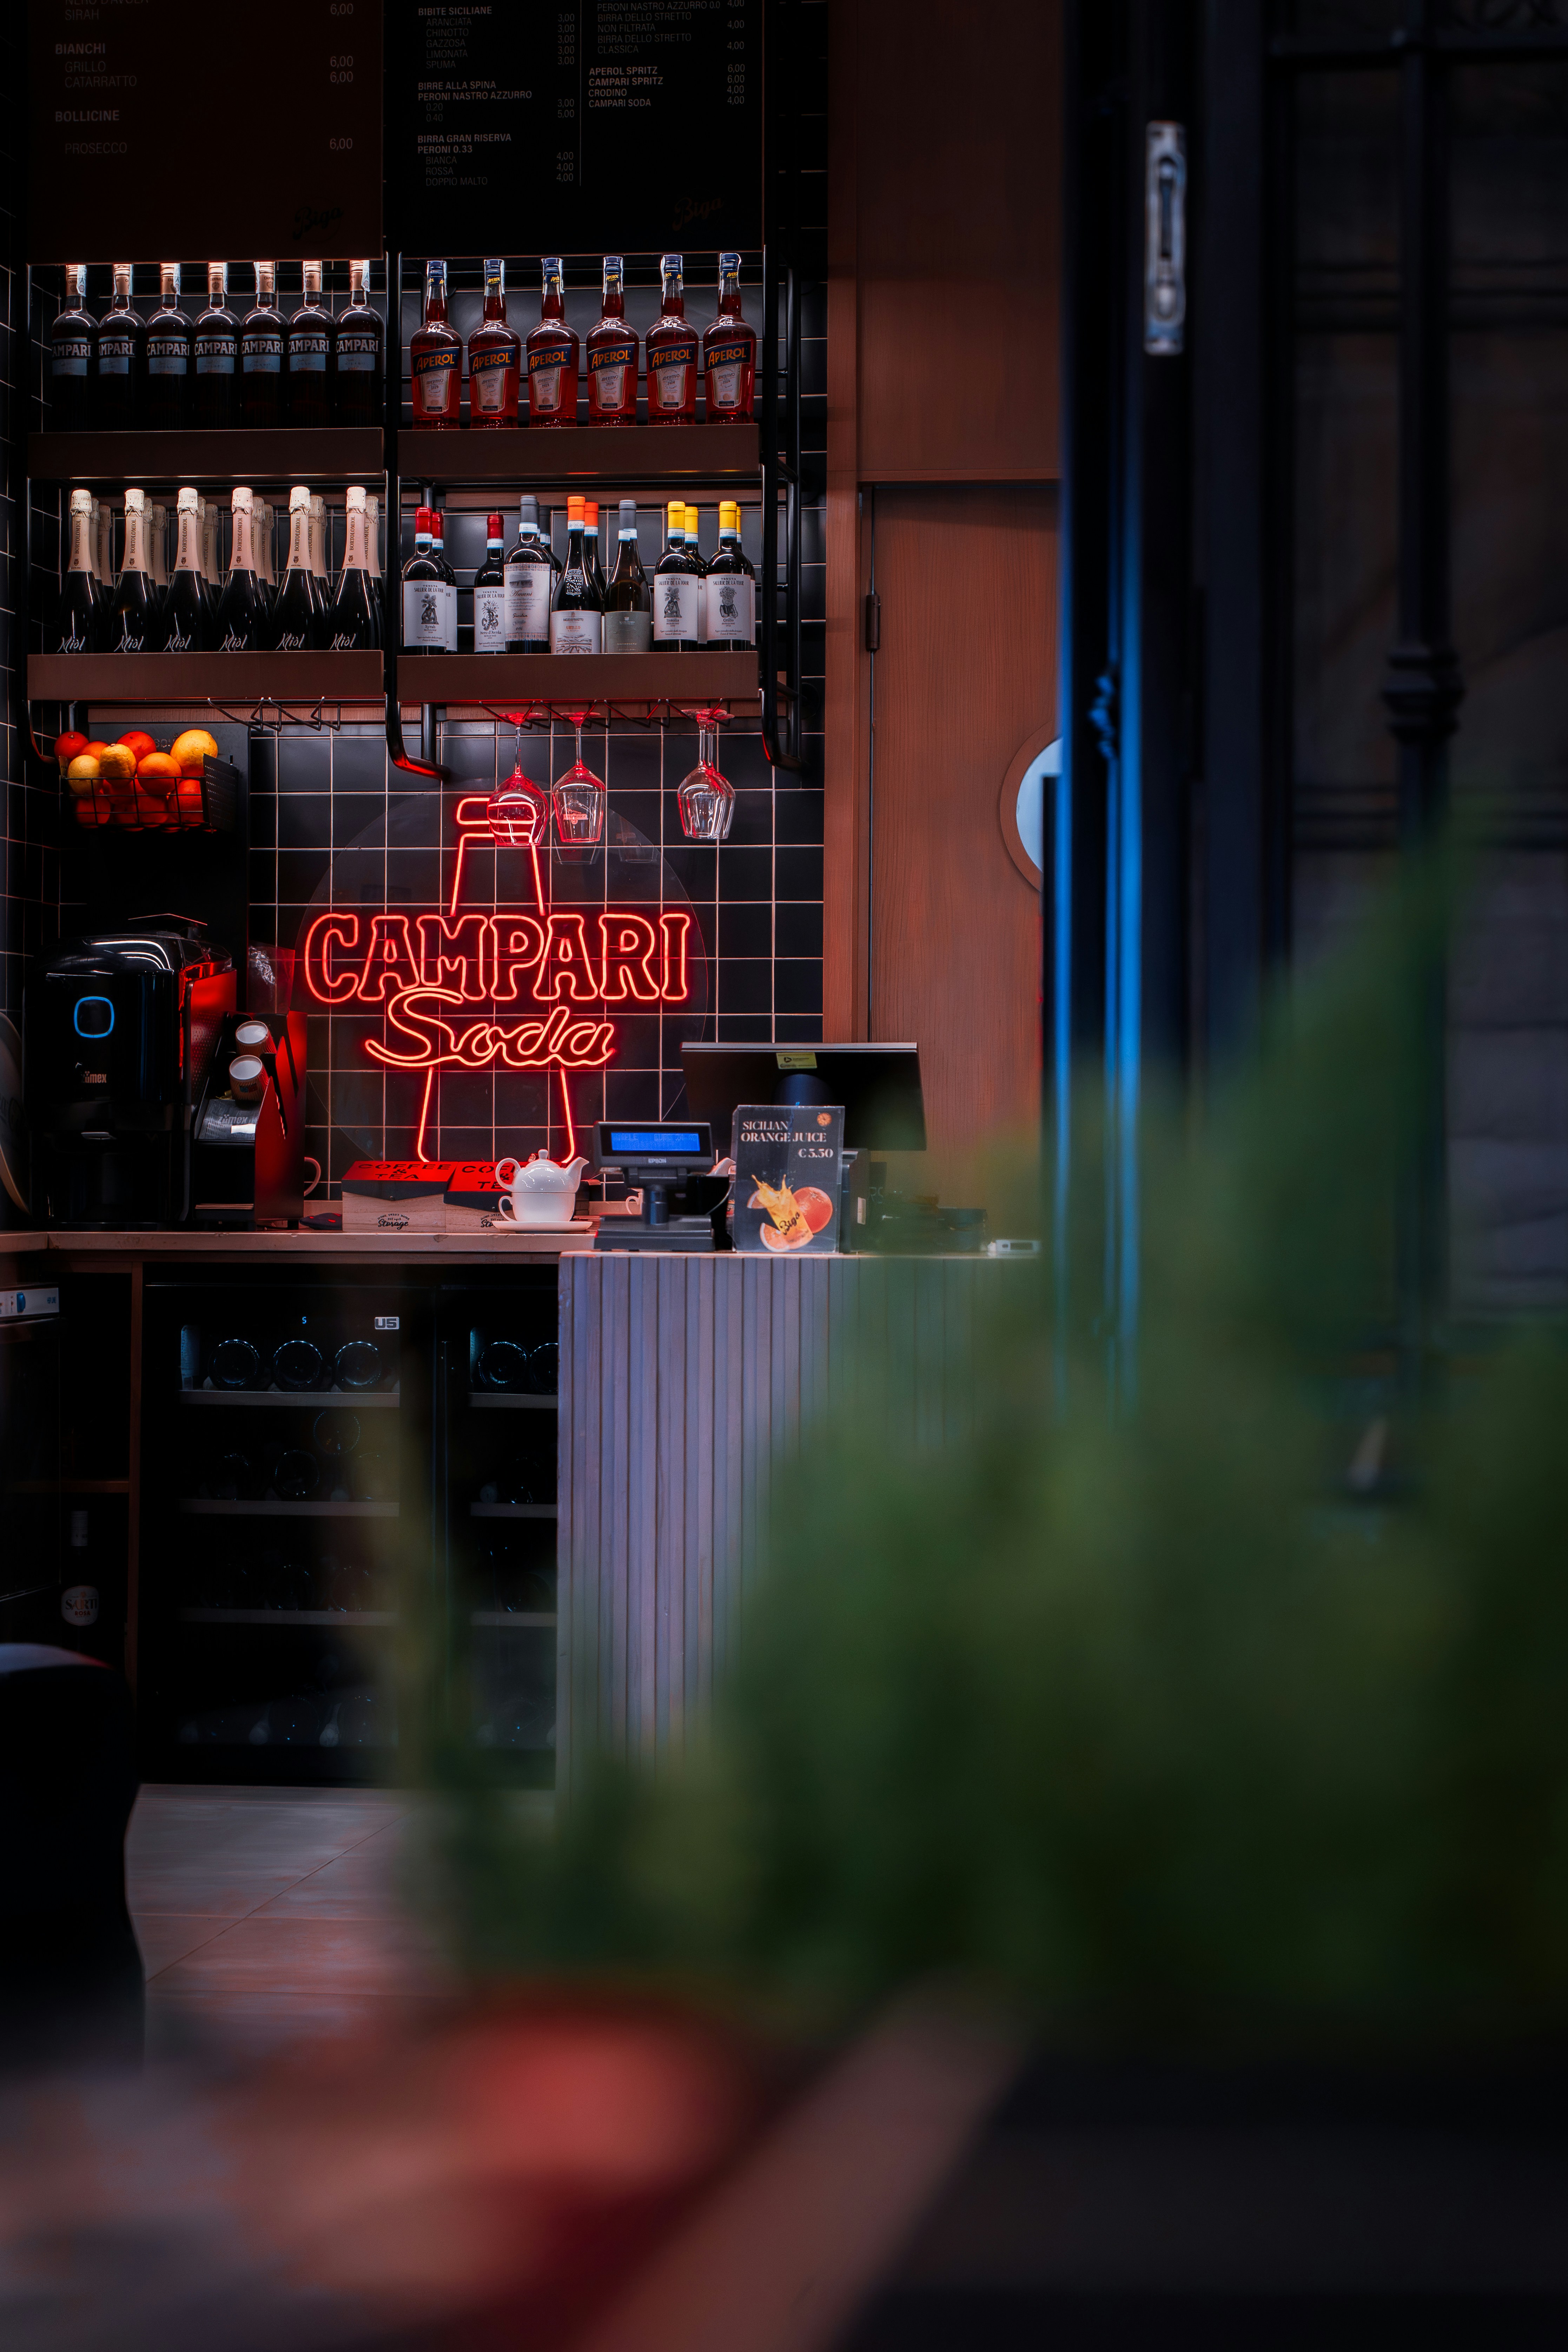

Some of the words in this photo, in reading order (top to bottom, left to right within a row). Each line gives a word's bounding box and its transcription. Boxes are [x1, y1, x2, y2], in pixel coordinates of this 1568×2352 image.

[65, 8, 99, 21] SIRAH
[330, 3, 354, 16] 6,00
[418, 7, 446, 16] BIBITE
[449, 6, 492, 15] SICILIANE
[597, 2, 628, 12] PERONI
[631, 1, 664, 11] NASTRO
[667, 0, 707, 10] AZZURRO
[709, 1, 720, 9] 0.0
[426, 18, 472, 27] ARANCIATA
[557, 13, 575, 23] 3,00
[597, 13, 623, 22] BIRRA
[625, 12, 652, 22] DELLO
[654, 12, 692, 21] STRETTO
[426, 28, 469, 37] CHINOTTO
[557, 24, 575, 34] 3,00
[597, 24, 617, 33] NON
[619, 23, 656, 32] FILTRATA
[727, 20, 745, 30] 4,00
[426, 39, 466, 48] GAZZOSA
[557, 34, 575, 44] 3,00
[597, 35, 623, 44] BIRRA
[625, 34, 652, 43] DELLO
[654, 33, 692, 42] STRETTO
[55, 42, 106, 55] BIANCHI
[426, 49, 468, 58] LIMONATA
[557, 45, 575, 55] 3,00
[597, 45, 639, 54] CLASSICA
[727, 41, 745, 51] 4,00
[65, 60, 106, 73] GRILLO
[330, 55, 353, 68] 6,00
[426, 60, 456, 69] SPUMA
[557, 56, 575, 66] 3,00
[589, 67, 624, 76] APEROL
[626, 66, 658, 75] SPRITZ
[728, 64, 745, 73] 6,00
[65, 75, 137, 88] CATARRATTO
[330, 71, 353, 84] 6,00
[418, 81, 443, 91] BIRRE
[445, 81, 468, 90] ALLA
[470, 80, 496, 90] SPINA
[589, 77, 629, 87] CAMPARI
[632, 77, 663, 86] SPRITZ
[727, 74, 745, 85] 6,00
[418, 92, 450, 101] PERONI
[453, 91, 488, 100] NASTRO
[490, 90, 532, 100] AZZURRO
[588, 88, 627, 98] CRODINO
[727, 85, 745, 95] 4,00
[426, 103, 443, 112] 0.20
[557, 99, 575, 108] 3,00
[588, 99, 626, 108] CAMPARI
[628, 98, 651, 107] SODA
[727, 96, 745, 106] 4,00
[55, 110, 120, 122] BOLLICINE
[426, 113, 443, 122] 0.40
[557, 109, 575, 119] 5,00
[417, 135, 445, 144] BIRRA
[446, 134, 472, 143] GRAN
[474, 133, 512, 142] RISERVA
[65, 142, 127, 154] PROSECCO
[329, 138, 353, 151] 6,00
[417, 145, 451, 154] PERONI
[453, 145, 473, 154] 0.33
[426, 155, 457, 165] BIANCA
[556, 152, 574, 161] 4,00
[426, 166, 454, 175] ROSSA
[556, 163, 574, 172] 4,00
[426, 177, 457, 186] DOPPIO
[460, 176, 488, 186] MALTO
[556, 173, 574, 183] 4,00
[671, 196, 725, 231] Biga
[293, 206, 343, 240] Biga
[53, 344, 91, 357] AMPARI
[146, 343, 190, 357] CAMPARI
[194, 342, 238, 356] CAMPARI
[242, 340, 284, 355] CAMPARI
[336, 339, 379, 353] CAMPARI
[416, 353, 455, 372] APEROL
[472, 352, 511, 372] APEROL
[529, 351, 566, 371] APEROL
[592, 349, 630, 369] APEROL
[652, 348, 691, 368] APEROL
[708, 347, 747, 367] APEROL
[304, 913, 690, 1003] CAMPARI
[364, 987, 616, 1067] Soda
[742, 1121, 789, 1131] SICILIAN
[740, 1132, 791, 1142] ORANGE
[792, 1132, 827, 1142] JUICE
[808, 1148, 834, 1158] 5.50
[378, 1219, 409, 1230] Storage
[779, 1211, 800, 1236] Biga
[66, 1598, 97, 1610] SARTI
